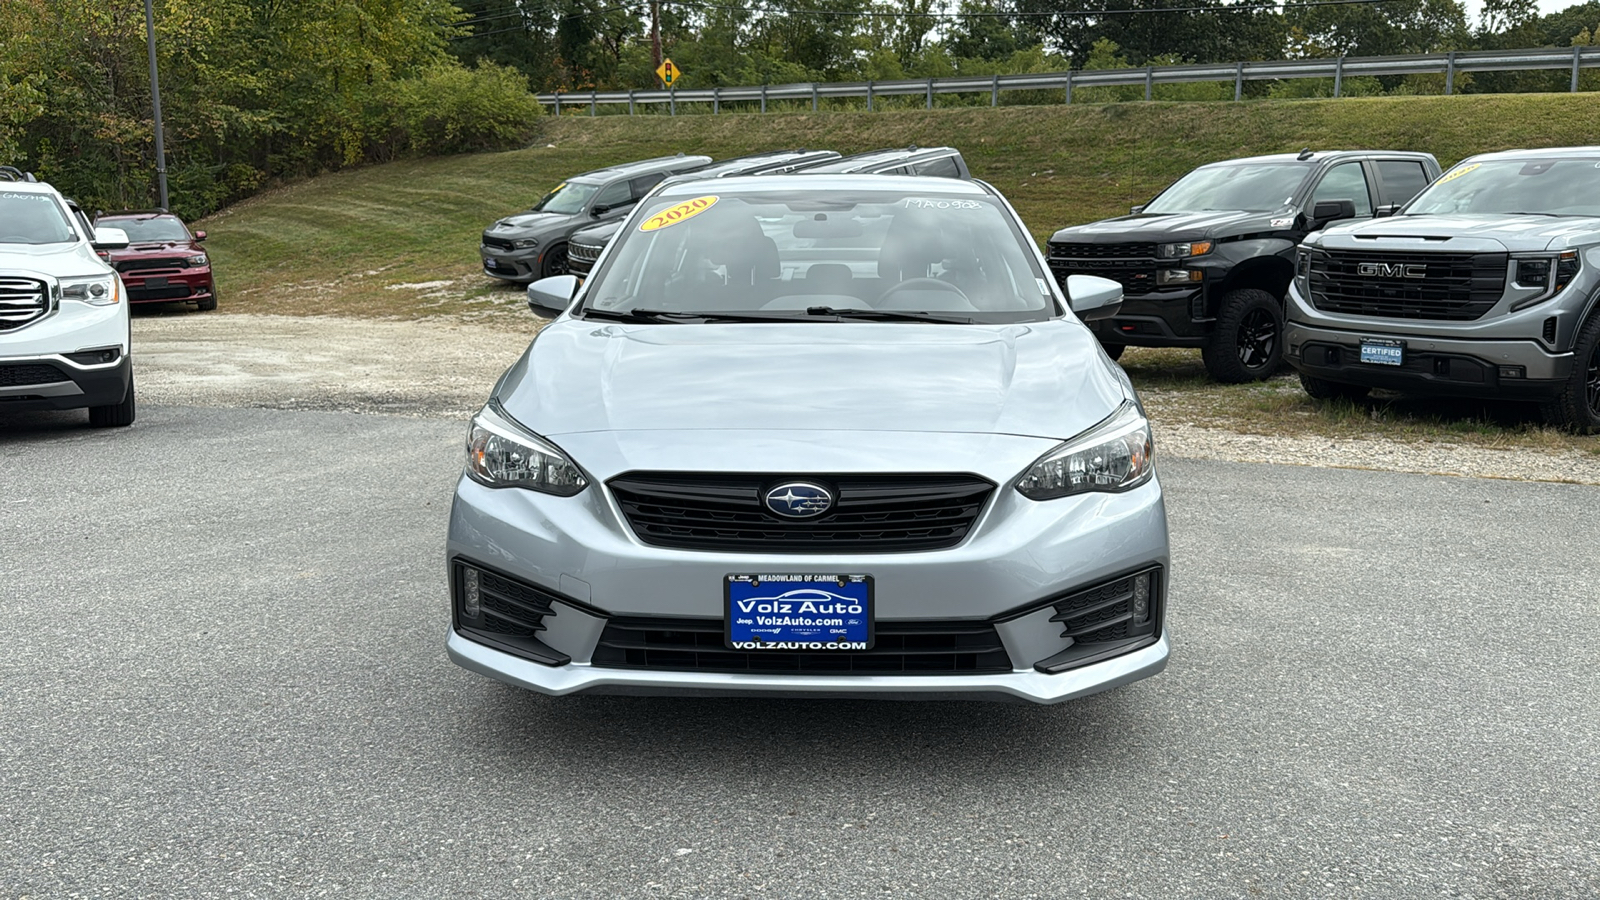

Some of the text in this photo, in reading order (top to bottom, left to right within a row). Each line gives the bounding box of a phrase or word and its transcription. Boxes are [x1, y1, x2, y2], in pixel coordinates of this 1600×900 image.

[651, 199, 708, 227] 2020
[1357, 262, 1427, 279] GMC
[1361, 347, 1402, 357] CERTIFIED
[758, 574, 802, 582] MEADOWLAND
[737, 601, 863, 614] Volz Auto
[756, 616, 843, 626] VolzAuto.com
[732, 642, 867, 650] VOLZAUTO.COM
